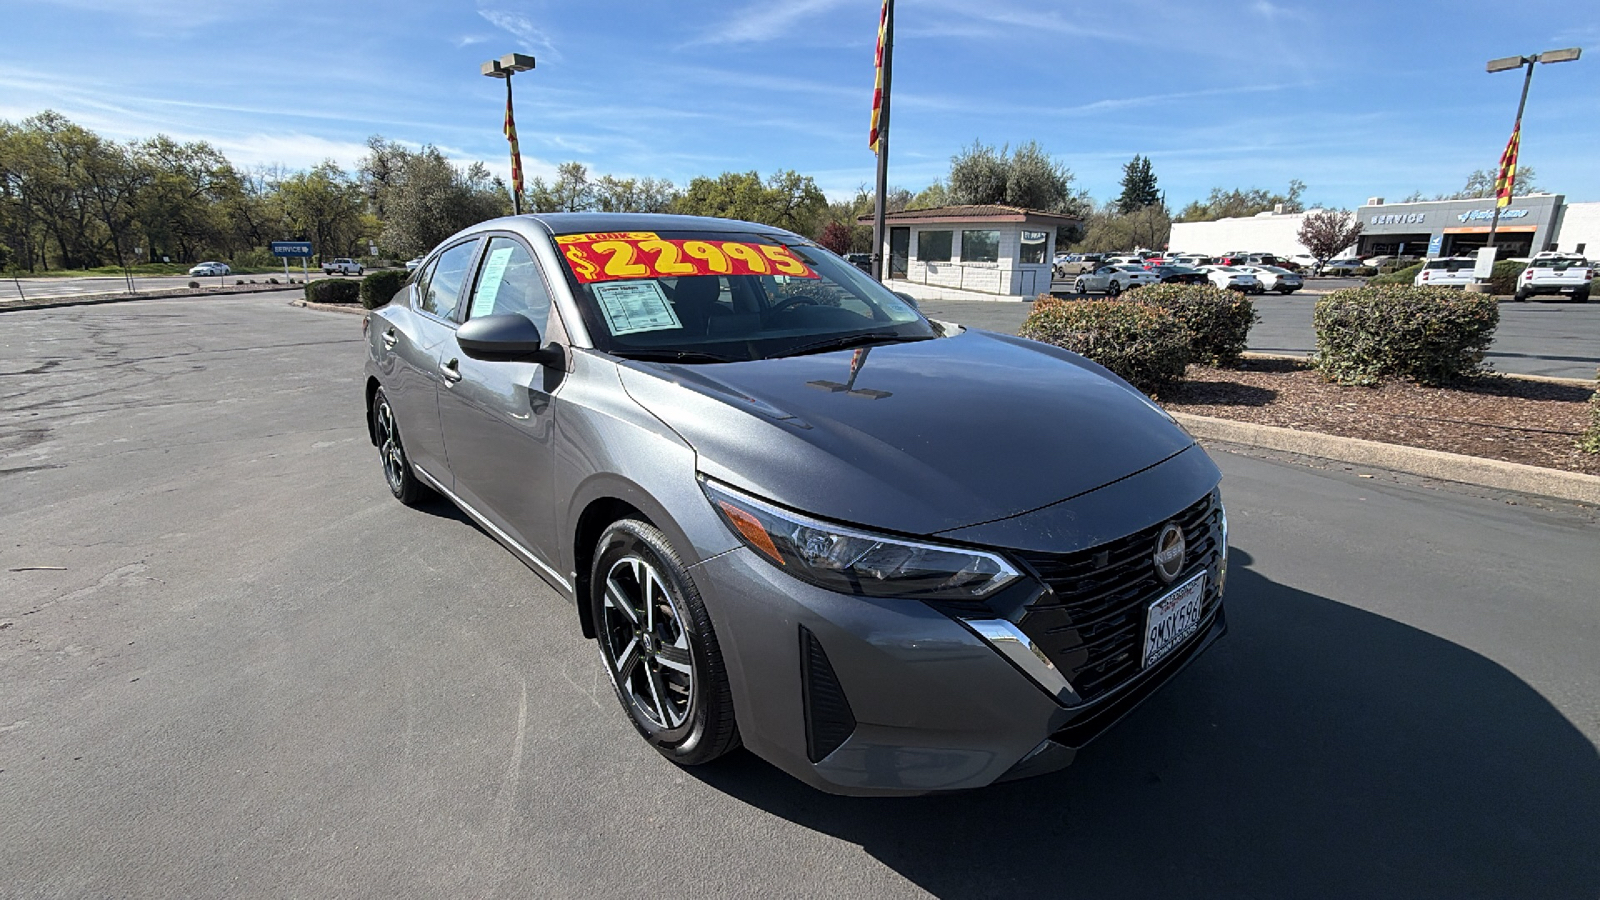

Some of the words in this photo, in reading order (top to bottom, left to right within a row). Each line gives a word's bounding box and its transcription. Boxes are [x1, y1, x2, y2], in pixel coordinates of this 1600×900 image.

[1370, 213, 1425, 225] SERVICE
[566, 241, 808, 280] $22995
[1148, 643, 1173, 665] CROWN
[1173, 623, 1198, 645] MOTORS
[1150, 596, 1198, 652] 9MSK596
